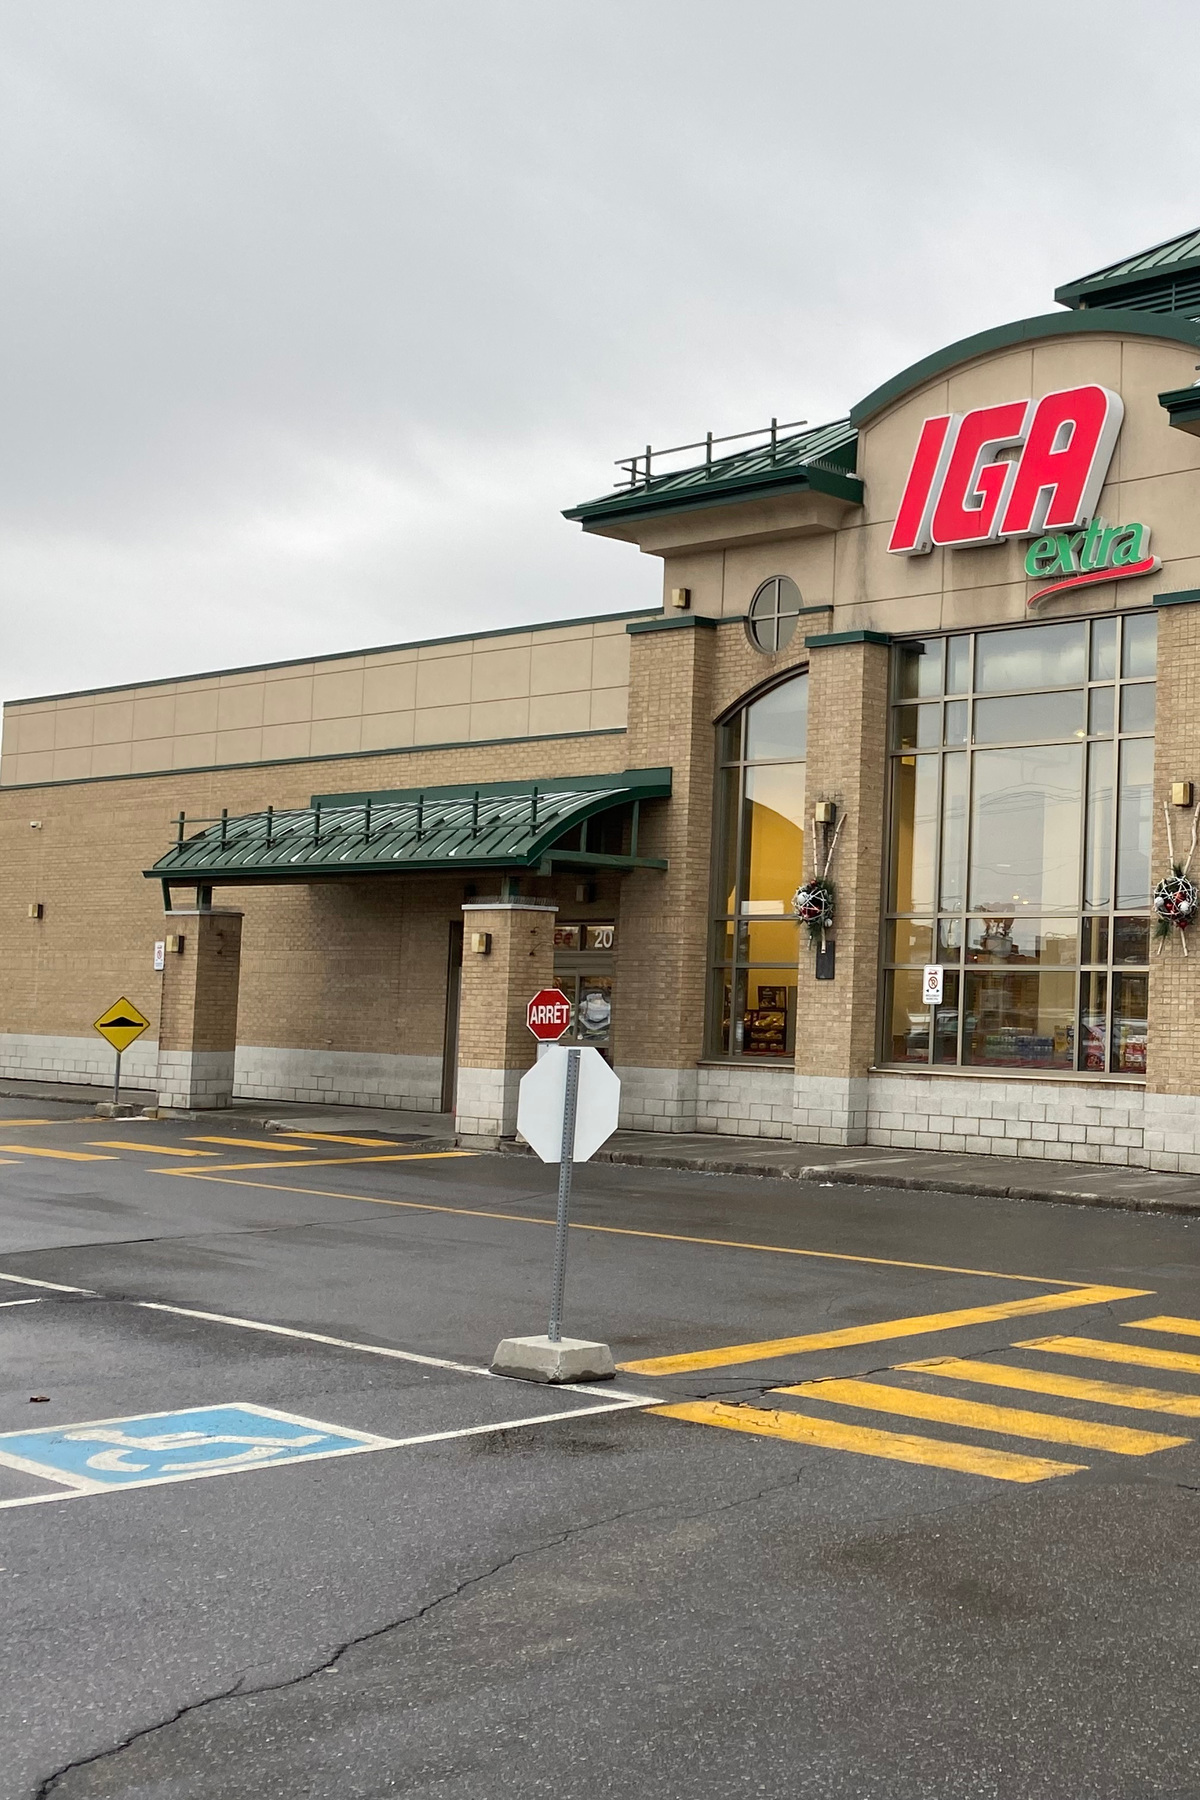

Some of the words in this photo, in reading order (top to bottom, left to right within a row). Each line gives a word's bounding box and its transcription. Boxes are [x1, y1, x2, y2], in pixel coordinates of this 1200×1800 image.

[887, 384, 1124, 556] IGA
[1024, 517, 1151, 577] extra
[594, 929, 613, 948] 20
[530, 1001, 569, 1024] ARRÊT
